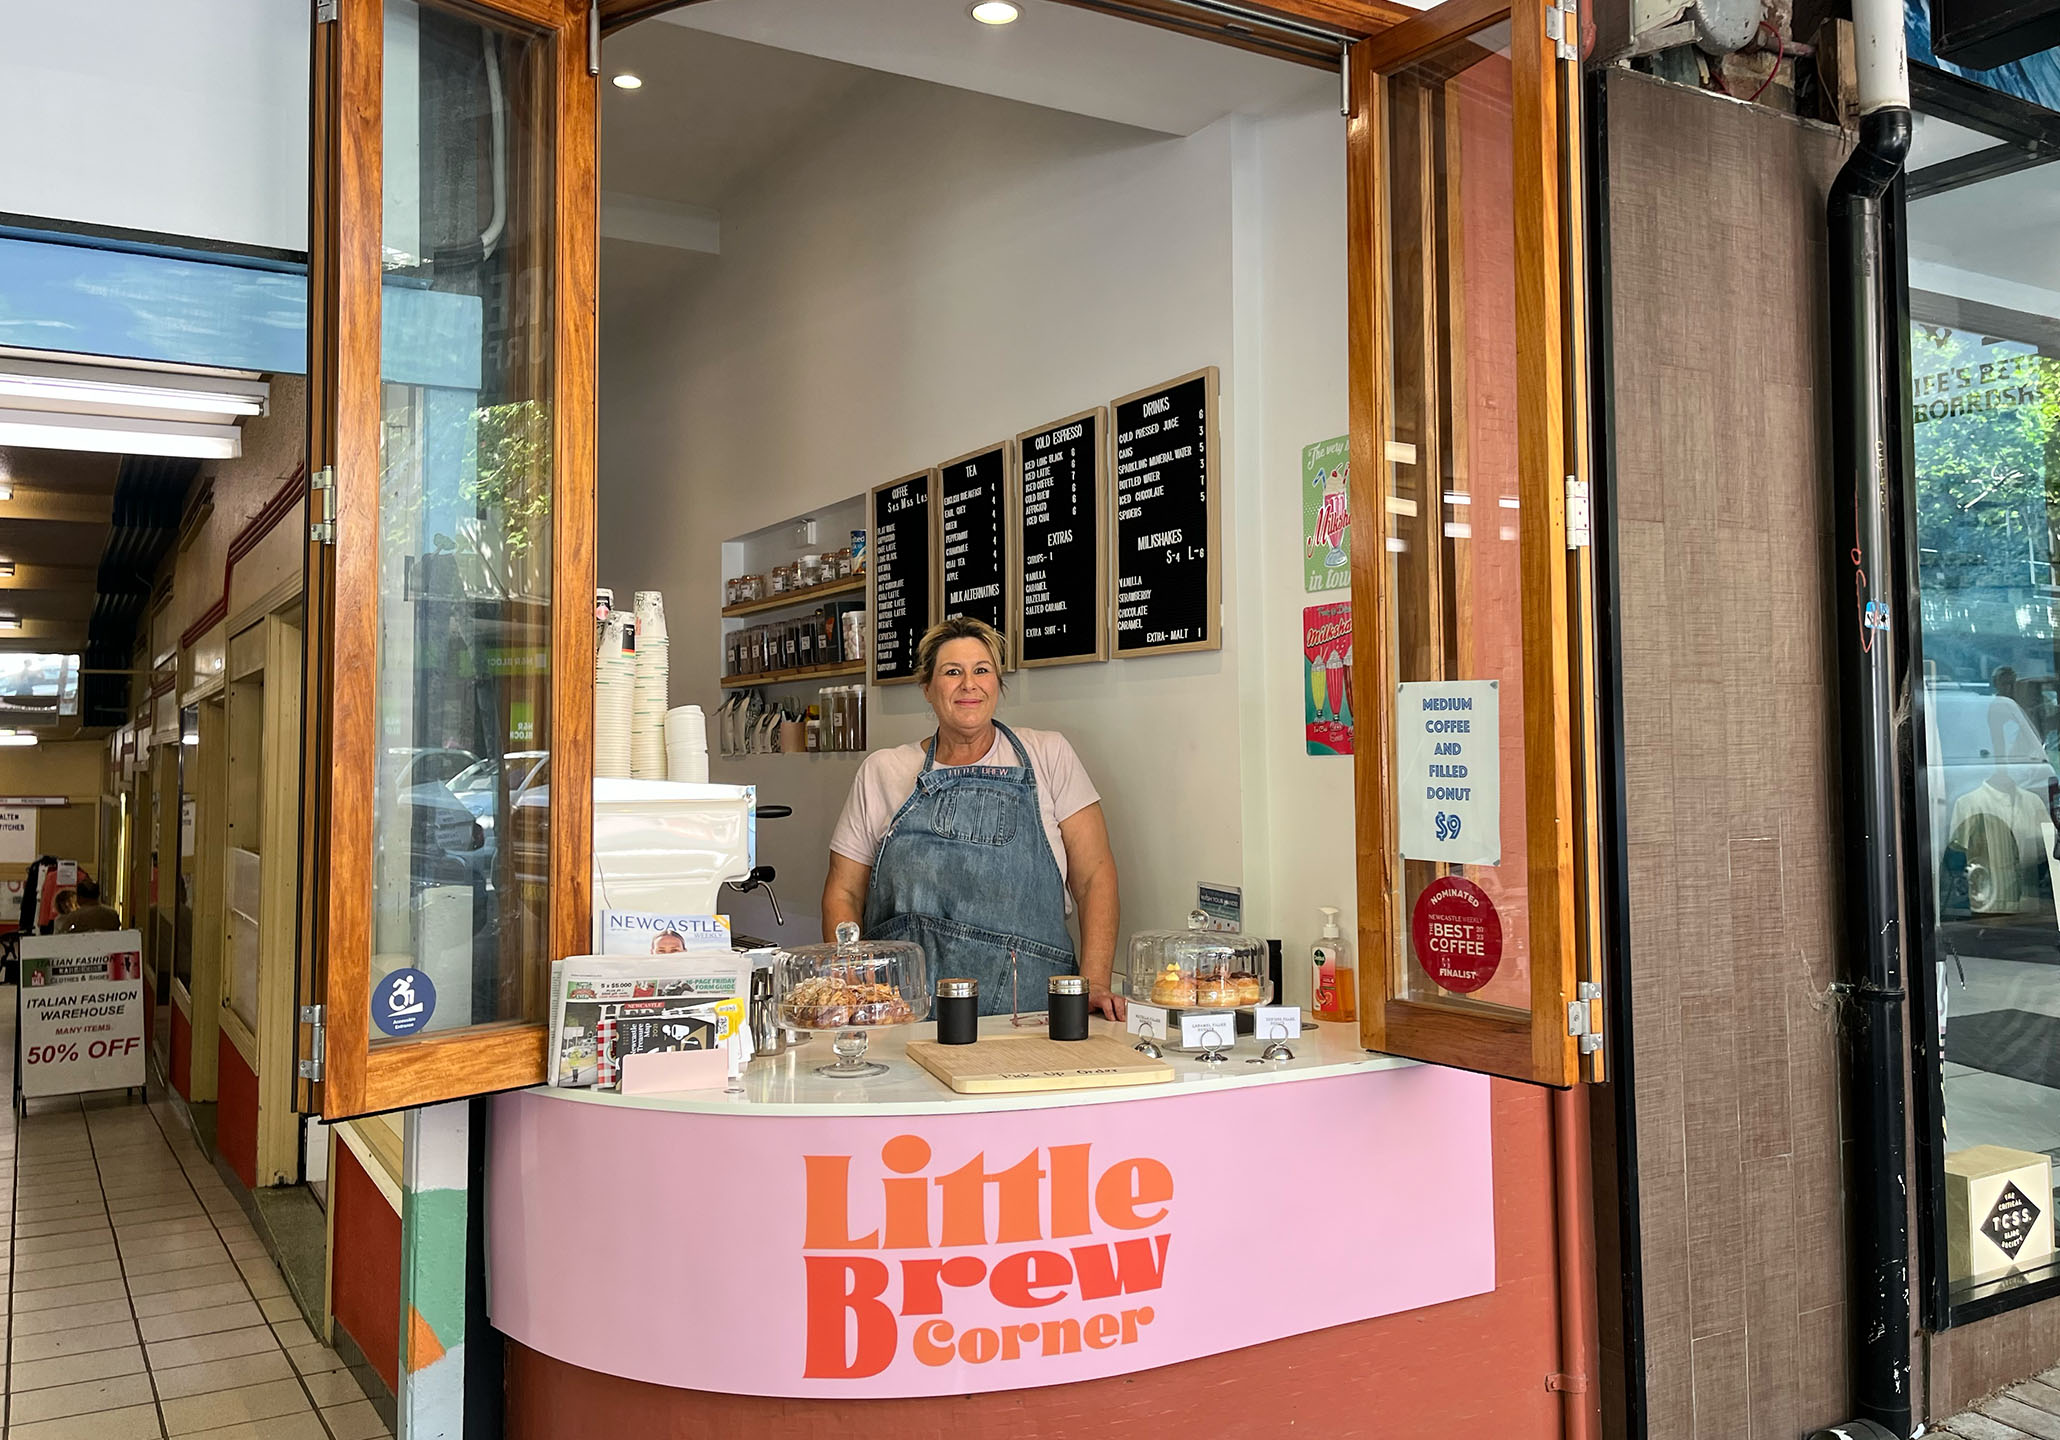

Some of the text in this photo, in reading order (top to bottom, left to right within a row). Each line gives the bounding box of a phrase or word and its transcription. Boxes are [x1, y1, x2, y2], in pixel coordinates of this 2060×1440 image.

[1143, 396, 1170, 418] DRINKS
[1035, 424, 1083, 450] COLD ESPRESSO
[1119, 432, 1134, 444] COLD
[1135, 423, 1160, 439] PRESSED
[1163, 416, 1180, 431] JUICE
[1118, 458, 1148, 475] SPARKLING
[1149, 451, 1174, 467] MINERAL
[1174, 446, 1192, 459] WATER
[1119, 447, 1134, 460] CANS
[1025, 460, 1036, 471] ICED
[1049, 452, 1064, 464] BLACK
[966, 464, 978, 478] TEA
[1025, 471, 1036, 482] ICED
[1037, 466, 1051, 478] LATTE
[1026, 482, 1036, 493] ICED
[1037, 476, 1055, 490] COFFEE
[1119, 476, 1142, 490] BOTTLED
[1143, 471, 1161, 484] WATER
[892, 485, 909, 500] COFFEE
[1025, 493, 1036, 504] COLD
[1119, 494, 1132, 506] ICED
[1135, 485, 1164, 502] CHOCOLATE
[1026, 515, 1038, 526] ICED
[1119, 507, 1142, 520] SPIDERS
[1048, 529, 1073, 547] EXTRAS
[1138, 529, 1183, 551] MILKSHAKES
[1119, 576, 1143, 588] VANILLA
[1308, 570, 1324, 592] in
[950, 583, 1000, 604] MILK ALTERNATIVES
[1119, 589, 1152, 604] STRAWBERRY
[1026, 604, 1044, 616] SALTED
[1118, 605, 1148, 619] CHOCOLATE
[1118, 619, 1143, 631] CARAMEL
[1170, 628, 1189, 640] MALT
[1422, 697, 1473, 712] MEDIUM
[1425, 720, 1471, 734] COFFEE
[1434, 743, 1462, 756] AND
[982, 768, 1008, 776] BREW
[1428, 765, 1468, 779] FILLED
[1426, 788, 1471, 801] DONUT
[1435, 812, 1462, 842] $9
[1430, 889, 1480, 908] NOMINATED
[610, 915, 723, 932] NEWCASTLE
[1428, 914, 1462, 922] NEWCASTLE
[1434, 923, 1474, 939] BEST
[1430, 938, 1485, 956] COFFEE
[76, 955, 115, 965] FASHION
[1439, 968, 1477, 980] FINALIST
[27, 990, 138, 1009] ITALIAN FASHION
[41, 1005, 125, 1021] WAREHOUSE
[56, 1027, 82, 1035] MANY
[644, 1023, 652, 1038] Map
[27, 1037, 141, 1065] 50% OFF
[802, 1134, 1174, 1251] Little
[2004, 1192, 2015, 1201] THE
[1998, 1199, 2023, 1212] CRITICAL
[802, 1233, 1172, 1379] Brew
